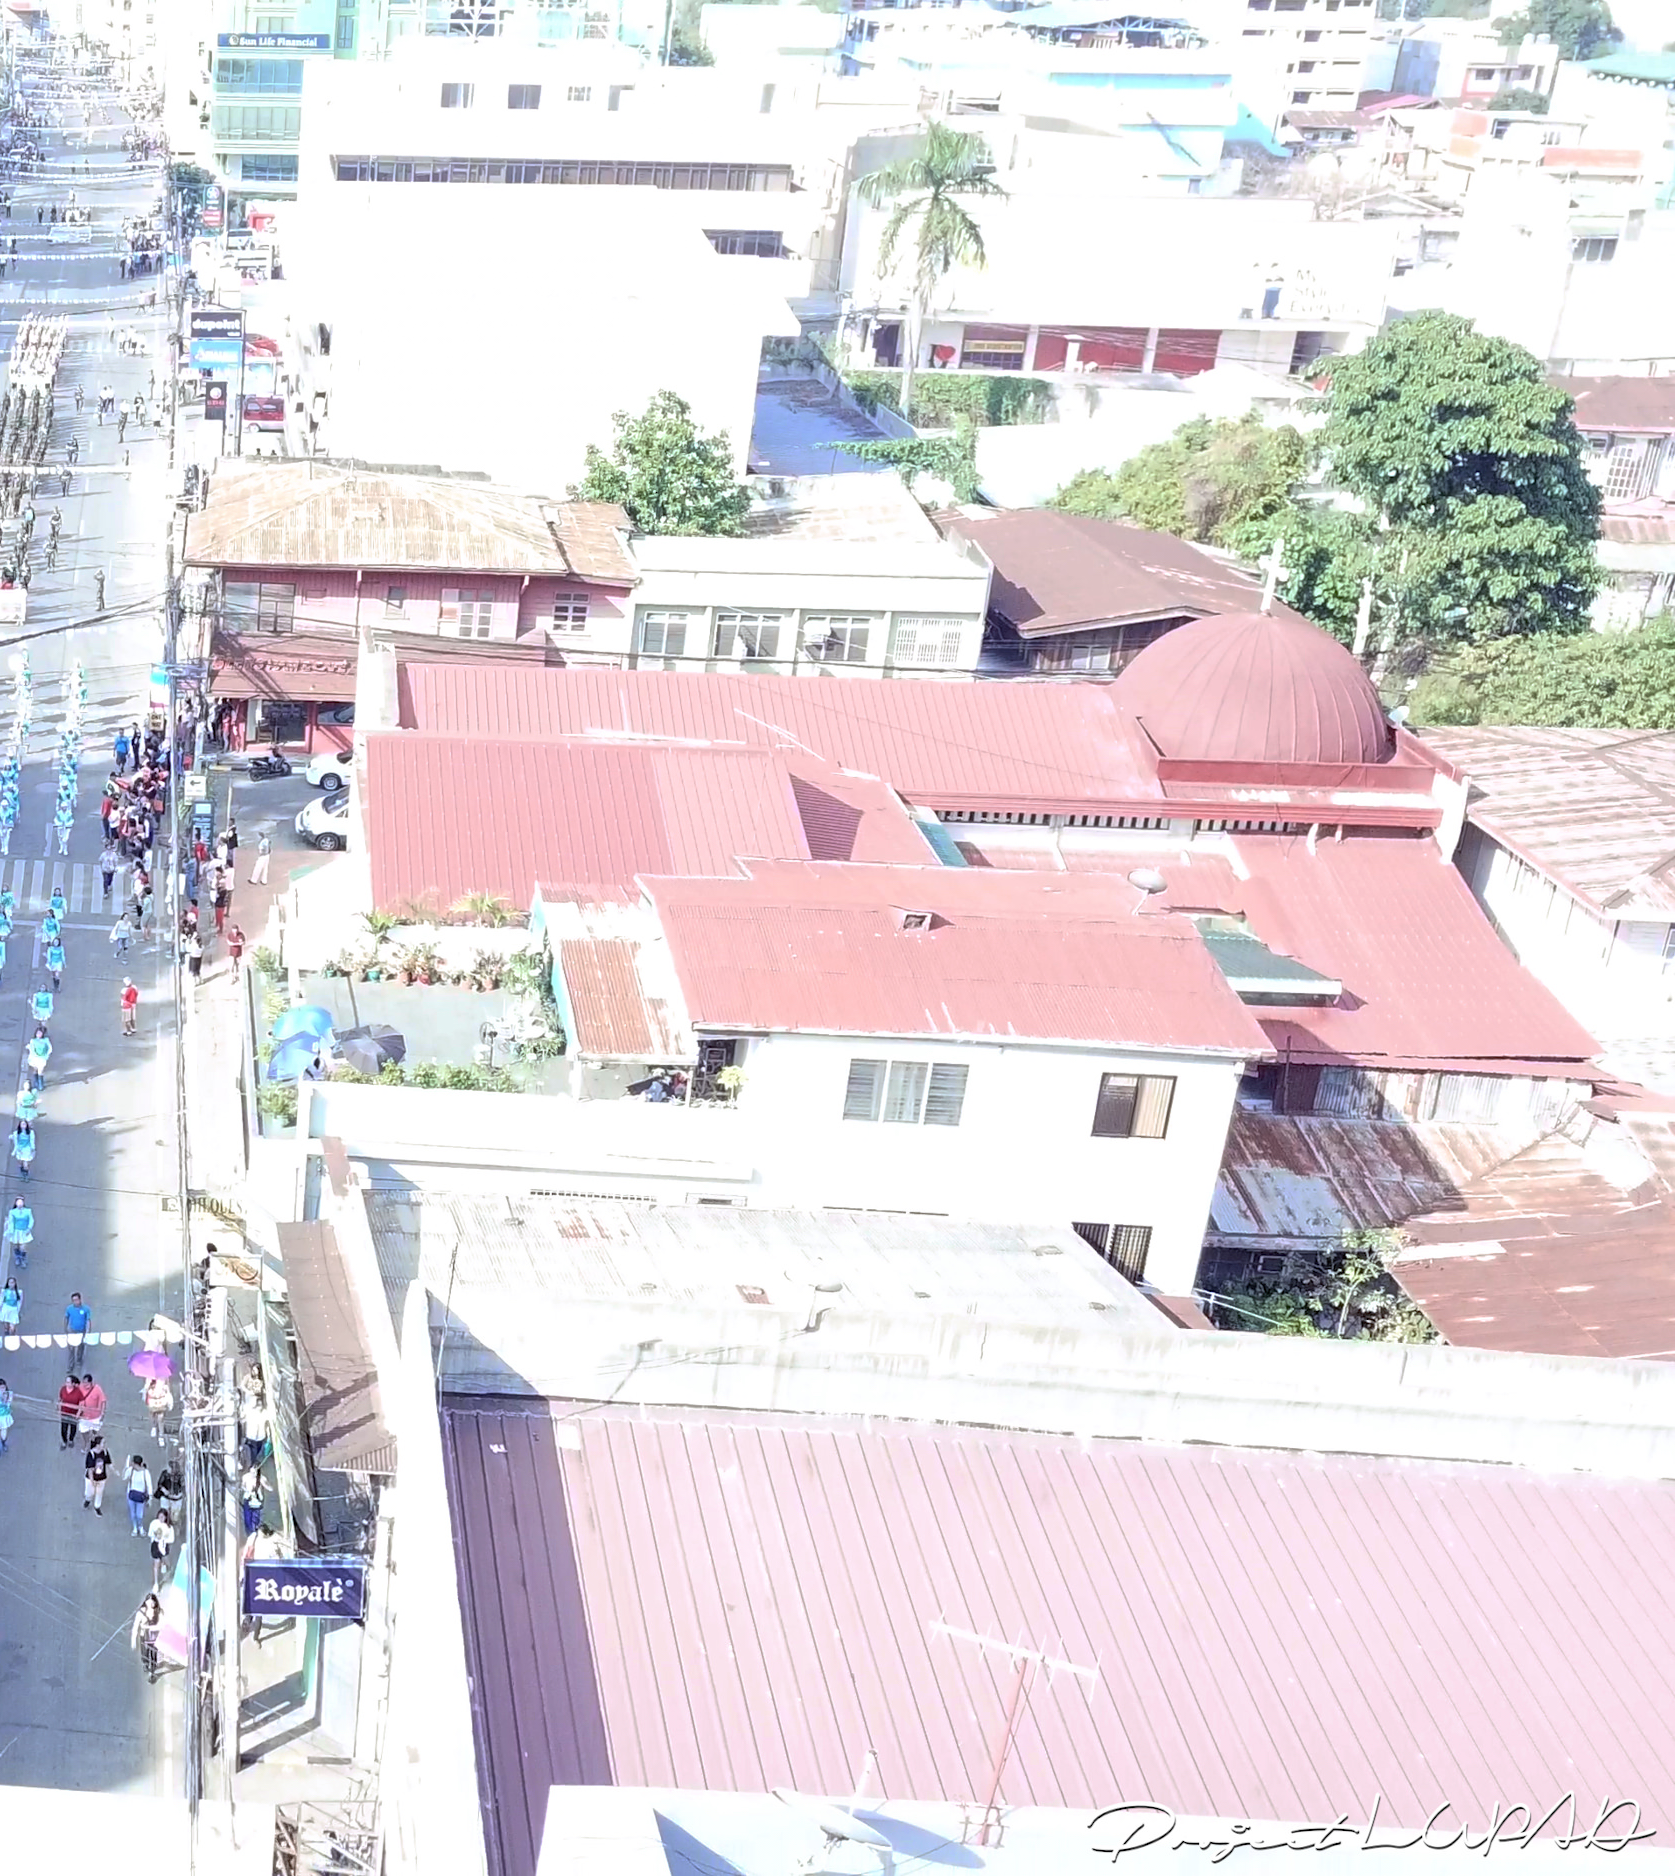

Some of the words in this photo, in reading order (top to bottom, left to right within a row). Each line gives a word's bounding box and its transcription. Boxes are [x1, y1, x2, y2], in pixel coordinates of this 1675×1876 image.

[239, 36, 257, 46] Sun
[258, 36, 276, 47] Life
[277, 36, 318, 48] Financial
[253, 1578, 344, 1606] Royalè
